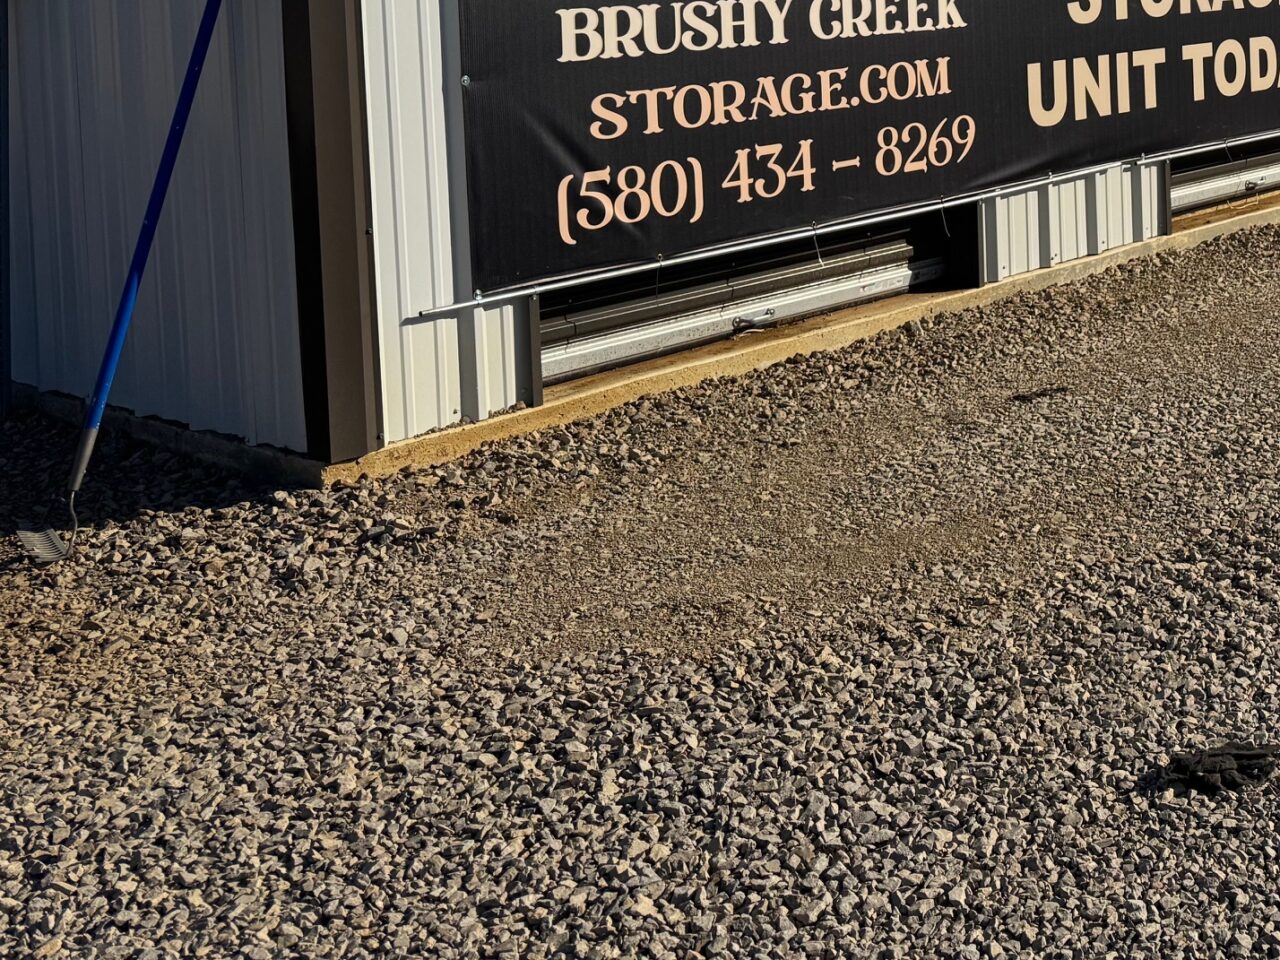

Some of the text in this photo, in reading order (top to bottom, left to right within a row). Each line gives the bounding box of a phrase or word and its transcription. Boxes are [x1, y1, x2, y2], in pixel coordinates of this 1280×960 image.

[590, 57, 952, 141] STORAGE.COM
[1026, 47, 1166, 128] UNIT
[557, 157, 704, 245] (580)
[722, 140, 816, 203] 434
[875, 114, 976, 177] 8269
